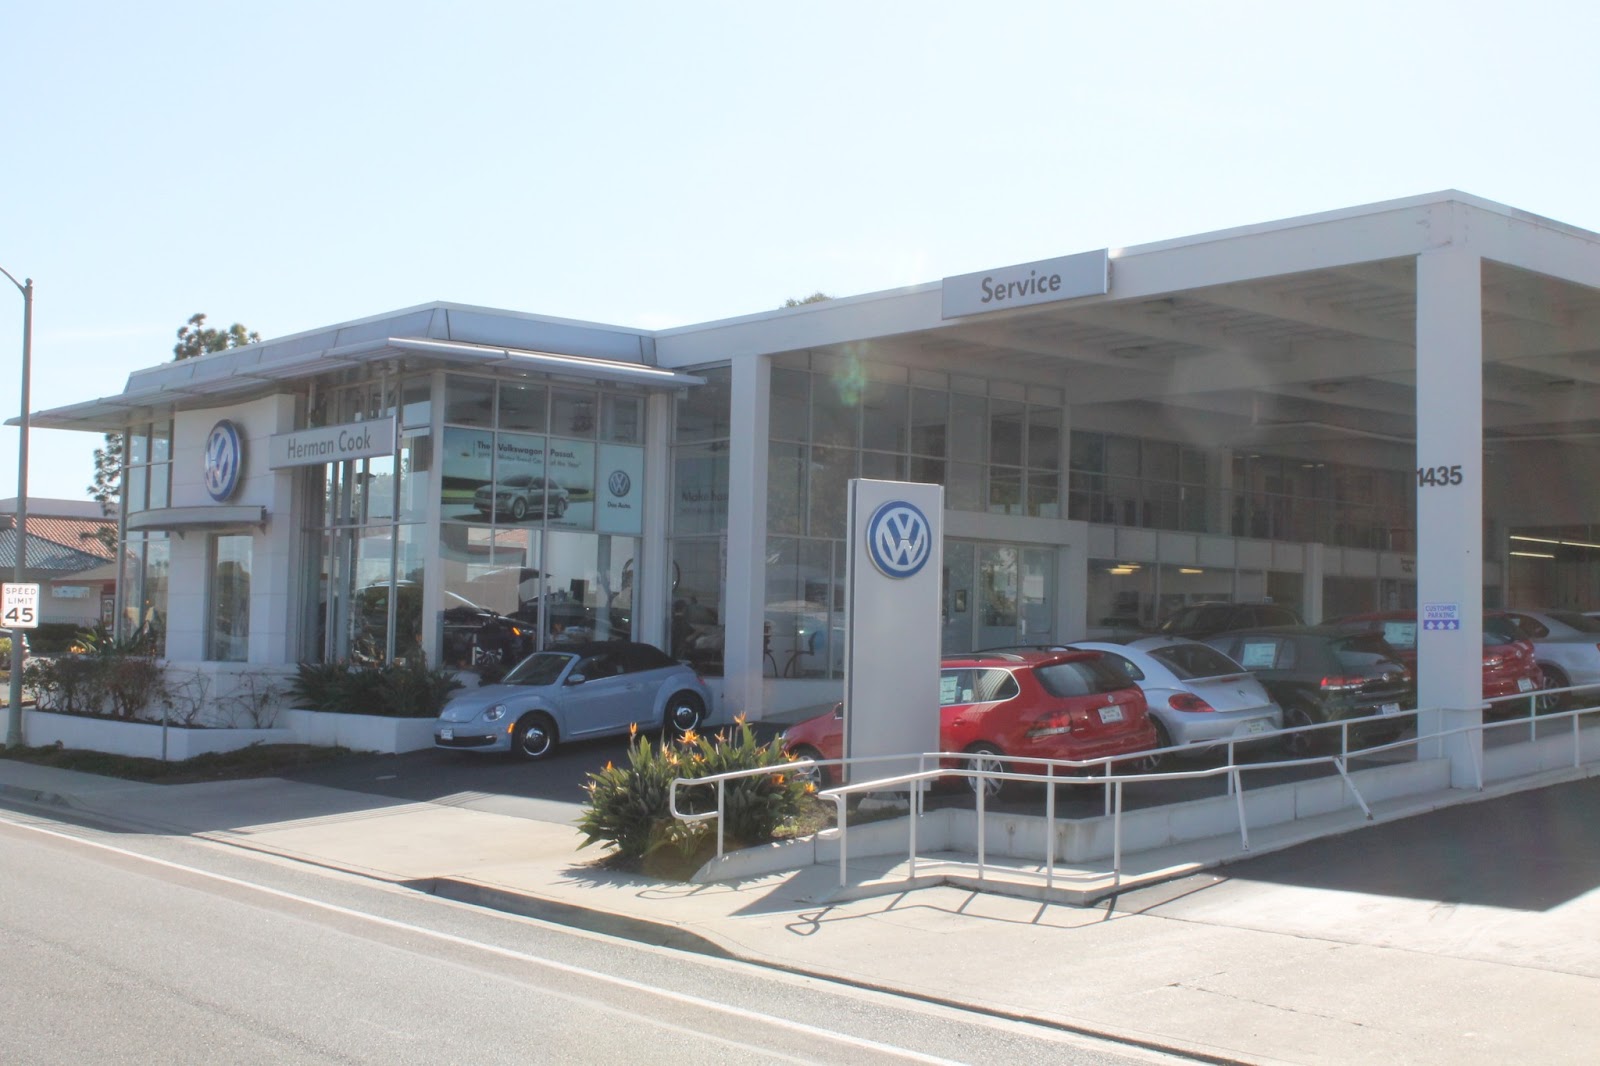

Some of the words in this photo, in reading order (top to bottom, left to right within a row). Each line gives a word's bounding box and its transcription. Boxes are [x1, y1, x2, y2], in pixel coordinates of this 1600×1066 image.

[981, 270, 1061, 303] Service
[287, 439, 334, 459] Herman
[338, 427, 371, 452] Cook
[477, 441, 491, 450] The
[1416, 465, 1463, 487] 1435
[5, 587, 36, 595] SPEED
[5, 607, 33, 622] 45
